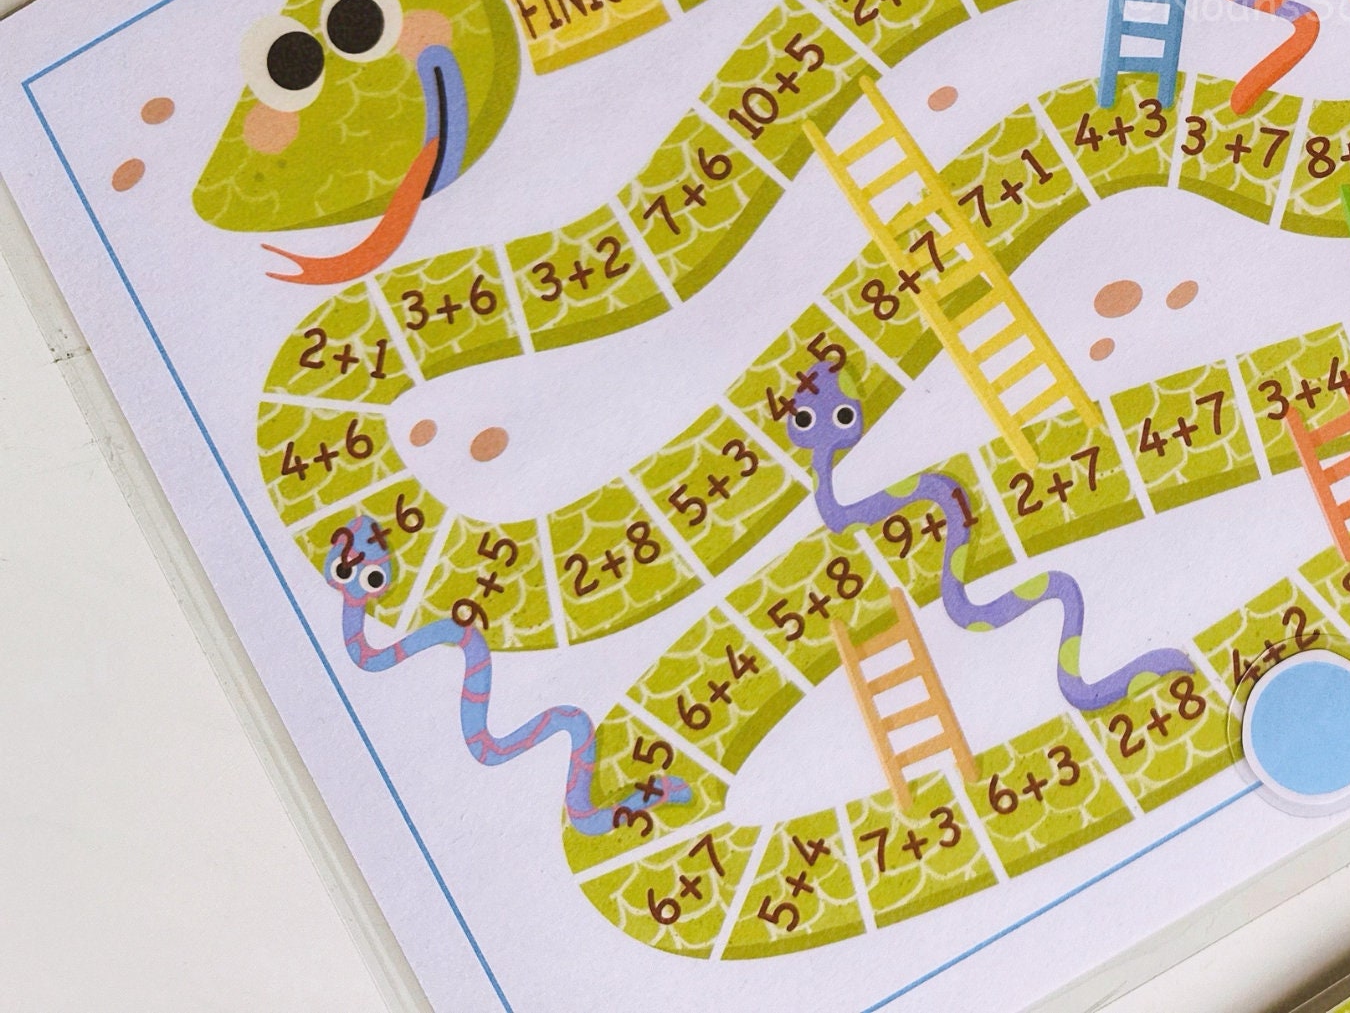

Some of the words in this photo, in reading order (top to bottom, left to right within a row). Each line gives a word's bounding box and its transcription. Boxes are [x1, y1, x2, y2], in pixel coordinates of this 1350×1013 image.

[729, 33, 824, 140] 10+5
[1075, 99, 1167, 151] 4+3
[643, 148, 732, 235] 7+6
[958, 150, 1053, 227] 7+1
[402, 275, 496, 330] 3+6
[532, 237, 629, 301] 3+2
[861, 231, 944, 320] 8+7
[300, 328, 387, 379] 2+1
[767, 332, 846, 420] 4+5
[281, 419, 373, 480] 4+6
[1140, 391, 1224, 456] 4+7
[669, 439, 758, 526] 5+3
[1010, 447, 1099, 516] 2+7
[331, 494, 425, 568] 2+6
[564, 522, 660, 596] 2+8
[883, 487, 978, 558] 9+1
[452, 532, 518, 630] 9+5
[768, 557, 863, 641] 5+8
[678, 645, 758, 730] 6+4
[1109, 676, 1205, 757] 2+8
[613, 737, 673, 837] 3+5
[989, 746, 1079, 814] 6+3
[860, 807, 960, 872] 7+3
[648, 835, 724, 925] 6+7
[758, 836, 830, 931] 5+4
